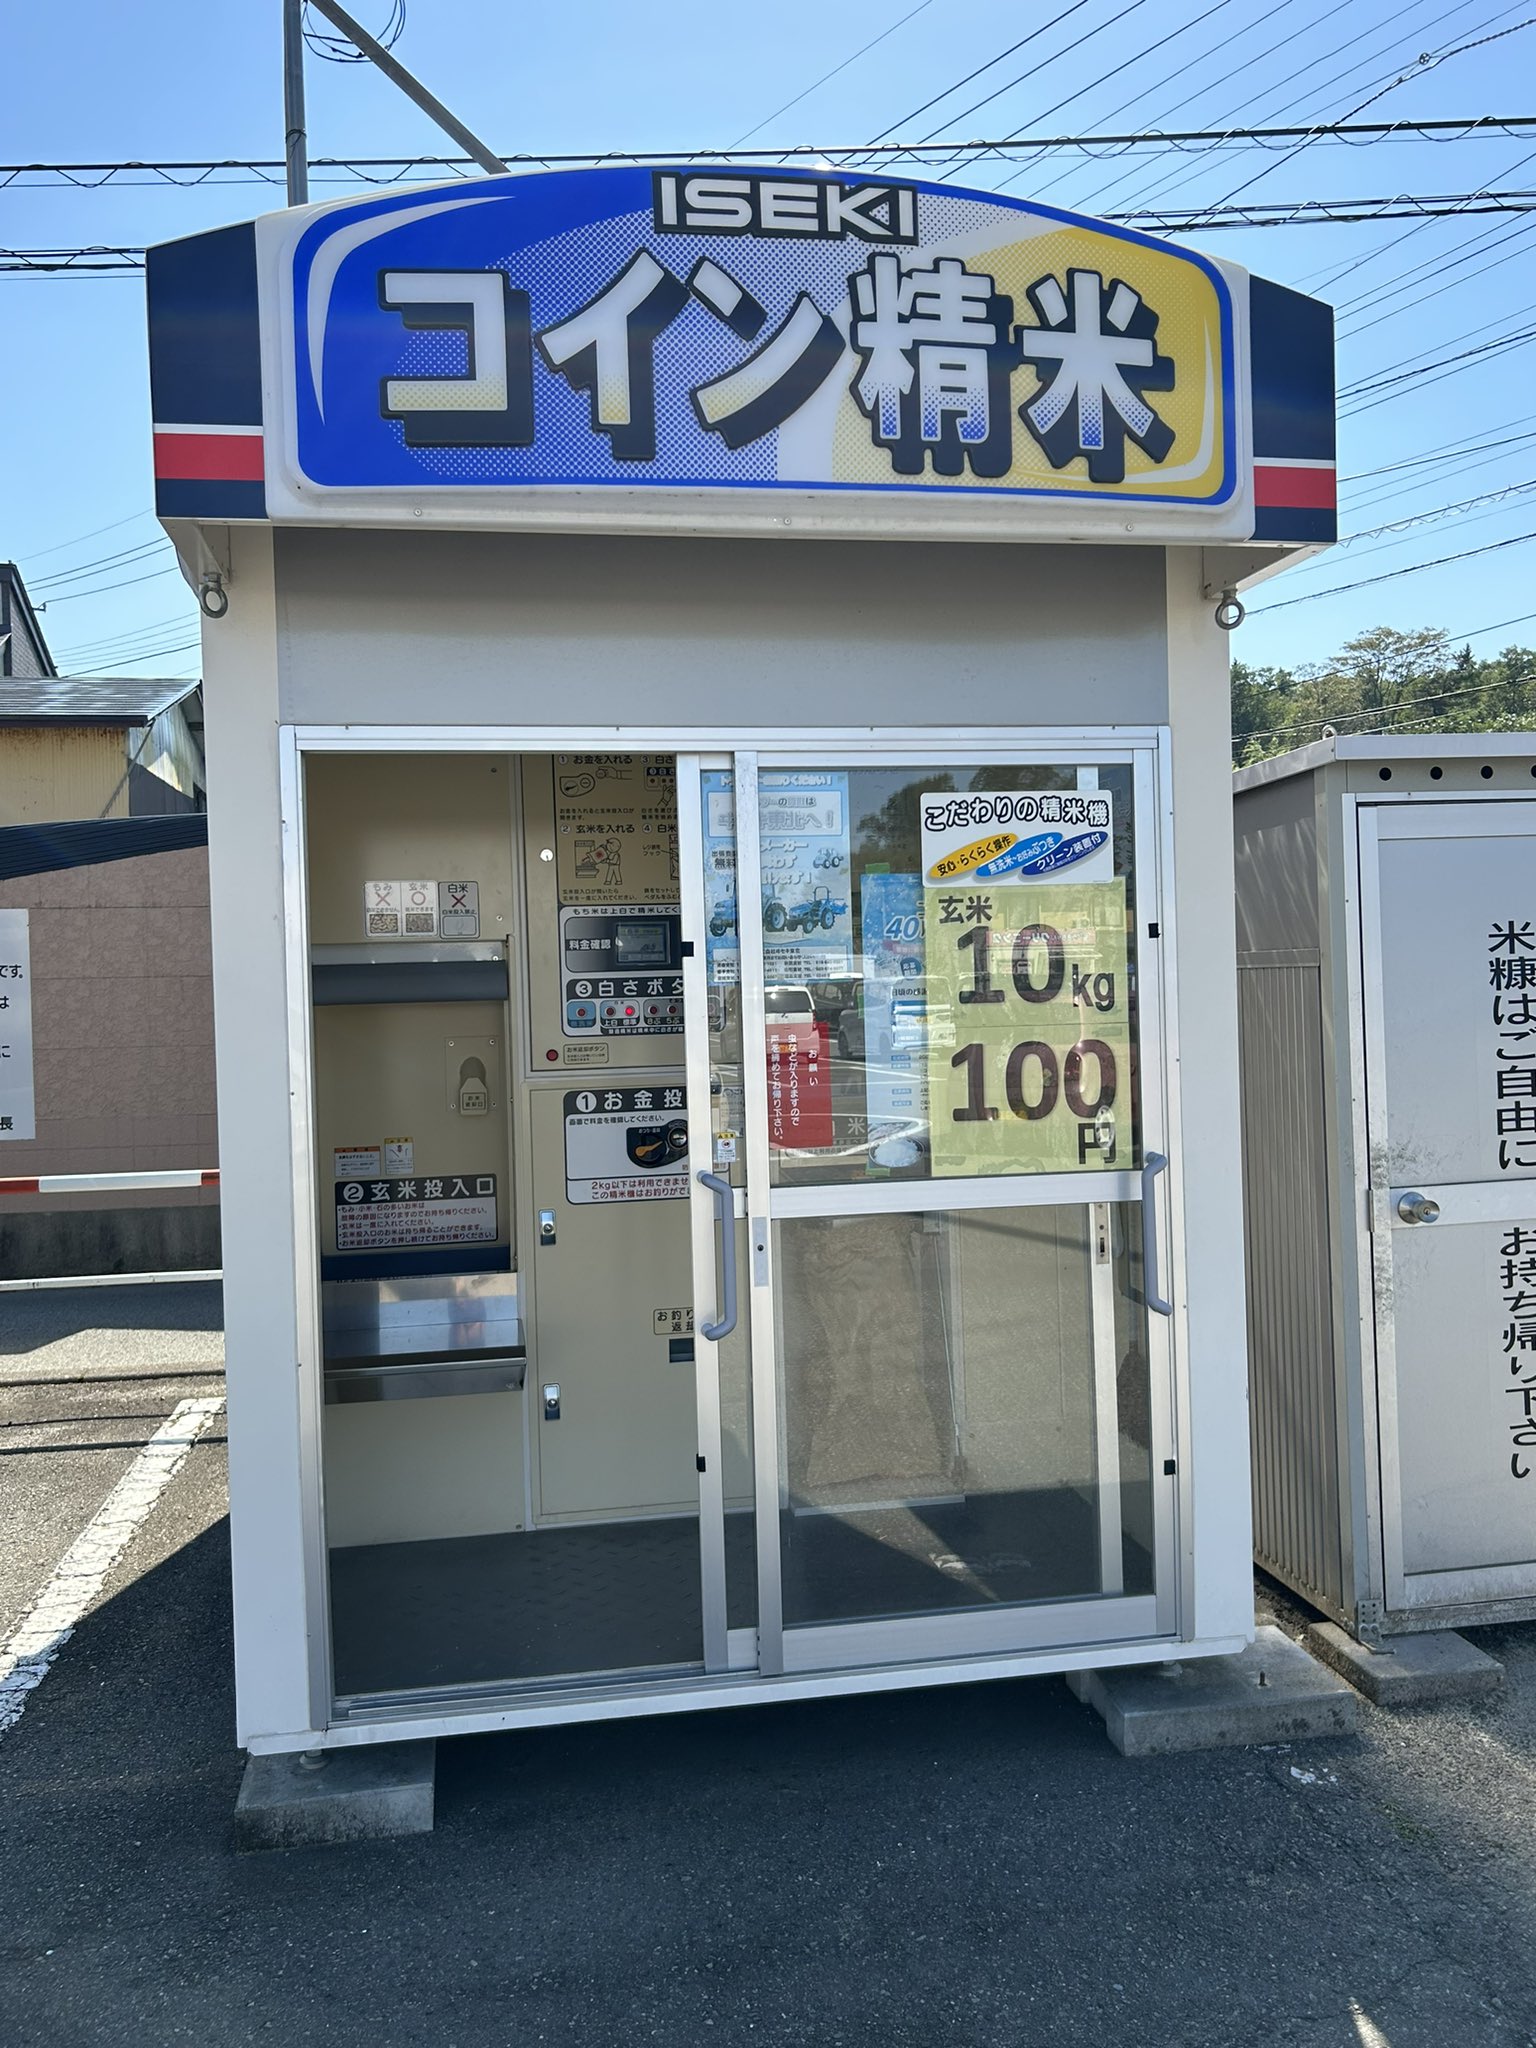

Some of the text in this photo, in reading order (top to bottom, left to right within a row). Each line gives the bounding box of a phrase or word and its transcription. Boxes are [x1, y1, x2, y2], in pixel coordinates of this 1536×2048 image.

[661, 176, 916, 239] ISEKI
[378, 250, 1175, 482] コイン精米
[576, 824, 635, 834] 玄米を入れる
[925, 796, 1110, 832] こだわりの精米機
[1036, 832, 1102, 871] クリーン装置付
[447, 883, 469, 893] 白米
[938, 896, 993, 925] 玄米
[568, 939, 612, 950] 料金確認
[1488, 920, 1536, 1170] 米糠はご自由に
[788, 1034, 800, 1126] 虫などが入りますので
[808, 1050, 819, 1087] お願い
[951, 1039, 1117, 1122] 100
[569, 1115, 665, 1126] 画面で料金を確認してください。
[1078, 1122, 1117, 1165] 円
